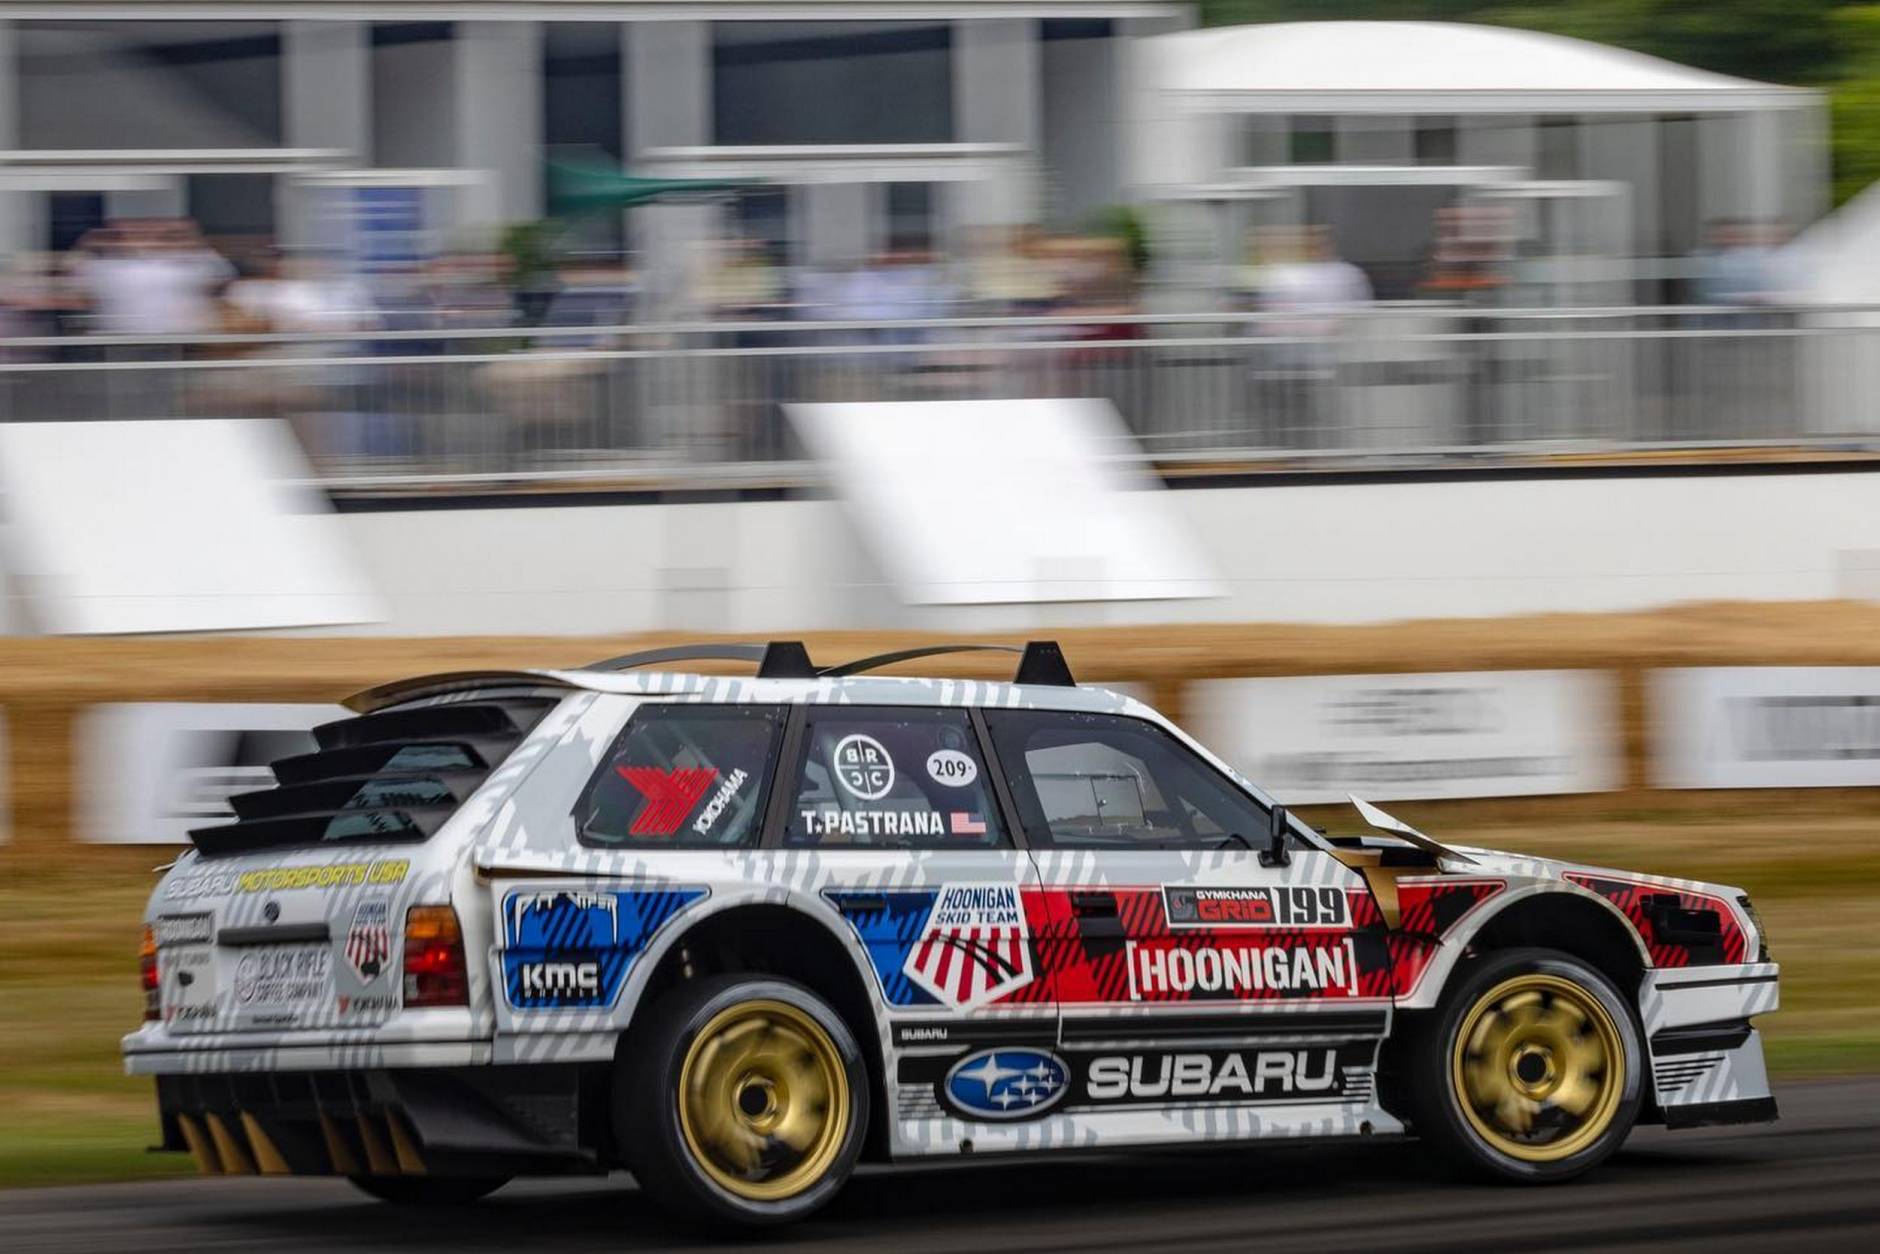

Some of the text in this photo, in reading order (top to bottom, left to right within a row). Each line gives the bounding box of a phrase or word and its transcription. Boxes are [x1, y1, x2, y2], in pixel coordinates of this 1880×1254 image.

[933, 759, 966, 777] 209
[692, 767, 748, 835] YOKOHAMA
[824, 810, 945, 835] PASTRANA
[239, 864, 365, 892] MOTORSPORTS
[369, 860, 408, 883] USA
[941, 887, 1017, 910] HOONIGAN
[1196, 890, 1268, 900] GYMKHANA
[1272, 887, 1346, 924] 199
[935, 911, 1019, 924] SKID TEAM
[901, 1028, 948, 1040] SUBARU
[1087, 1049, 1337, 1099] SUBARU
